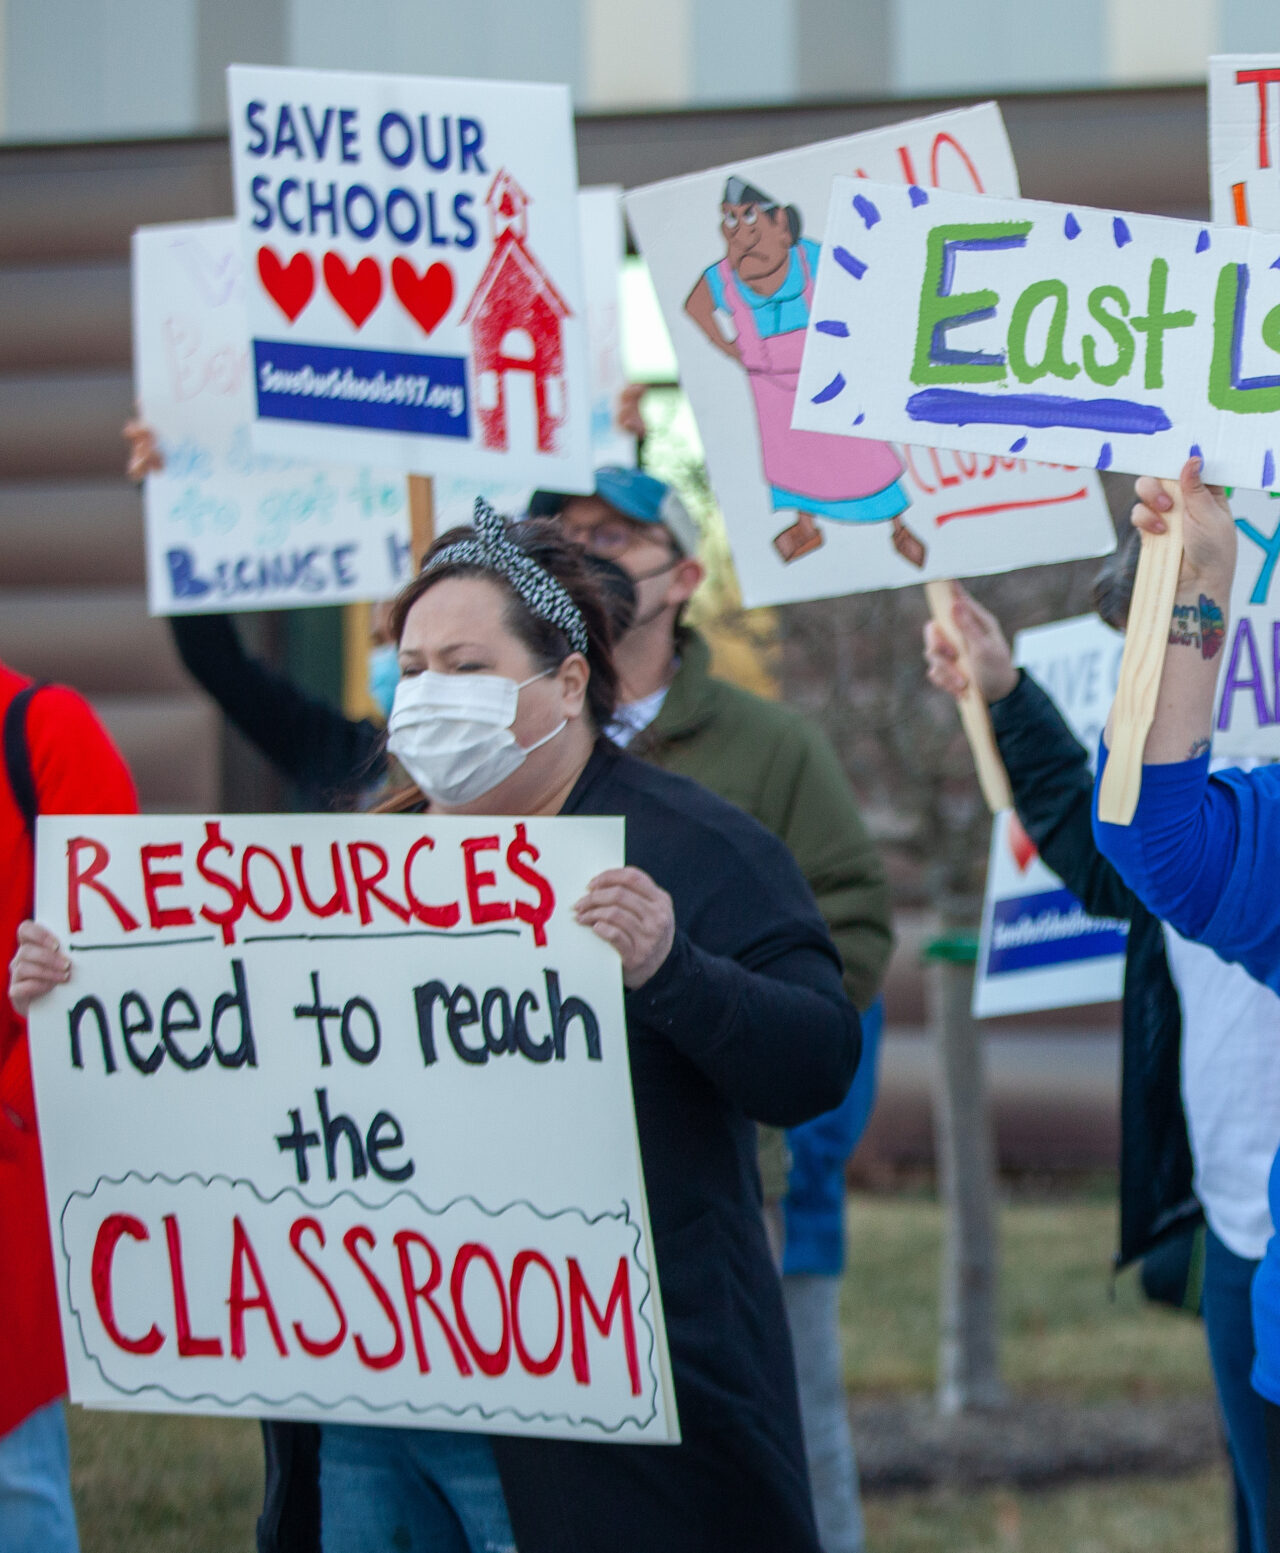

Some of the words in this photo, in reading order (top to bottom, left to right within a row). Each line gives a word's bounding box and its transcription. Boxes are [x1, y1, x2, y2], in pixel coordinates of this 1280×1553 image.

[245, 100, 360, 164] SAVE
[377, 111, 489, 175] OUR
[250, 176, 479, 250] SCHOOLS
[909, 219, 1198, 390] East
[67, 958, 259, 1074] need
[294, 970, 381, 1066] to
[413, 968, 602, 1066] reach
[274, 1088, 415, 1184] the
[91, 1213, 642, 1398] CLASSROOM
